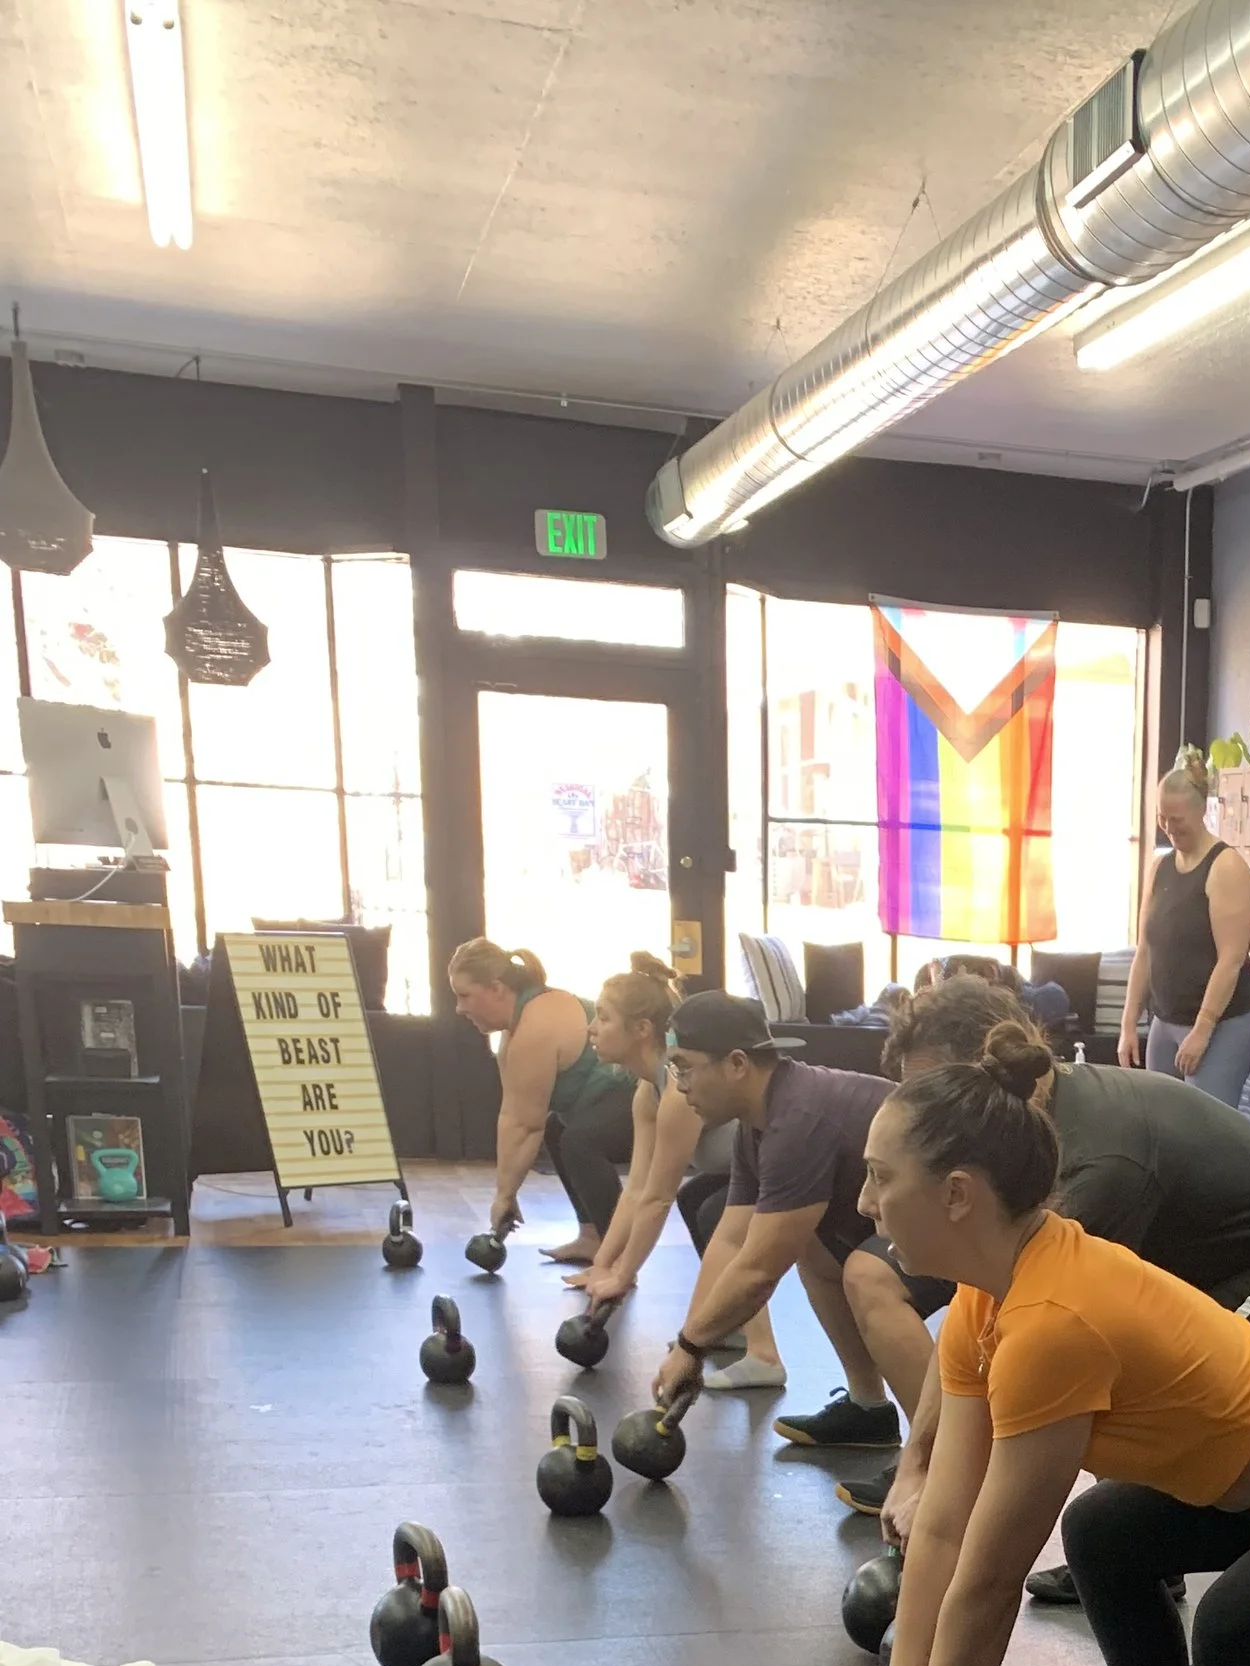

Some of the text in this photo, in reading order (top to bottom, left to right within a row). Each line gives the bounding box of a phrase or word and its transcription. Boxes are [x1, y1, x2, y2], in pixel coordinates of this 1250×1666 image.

[547, 512, 597, 556] EXIT
[258, 944, 317, 974] WHAT
[251, 991, 342, 1020] KIND OF
[276, 1037, 342, 1065] BEAST
[301, 1083, 339, 1112] ARE
[303, 1128, 356, 1157] YOU?
